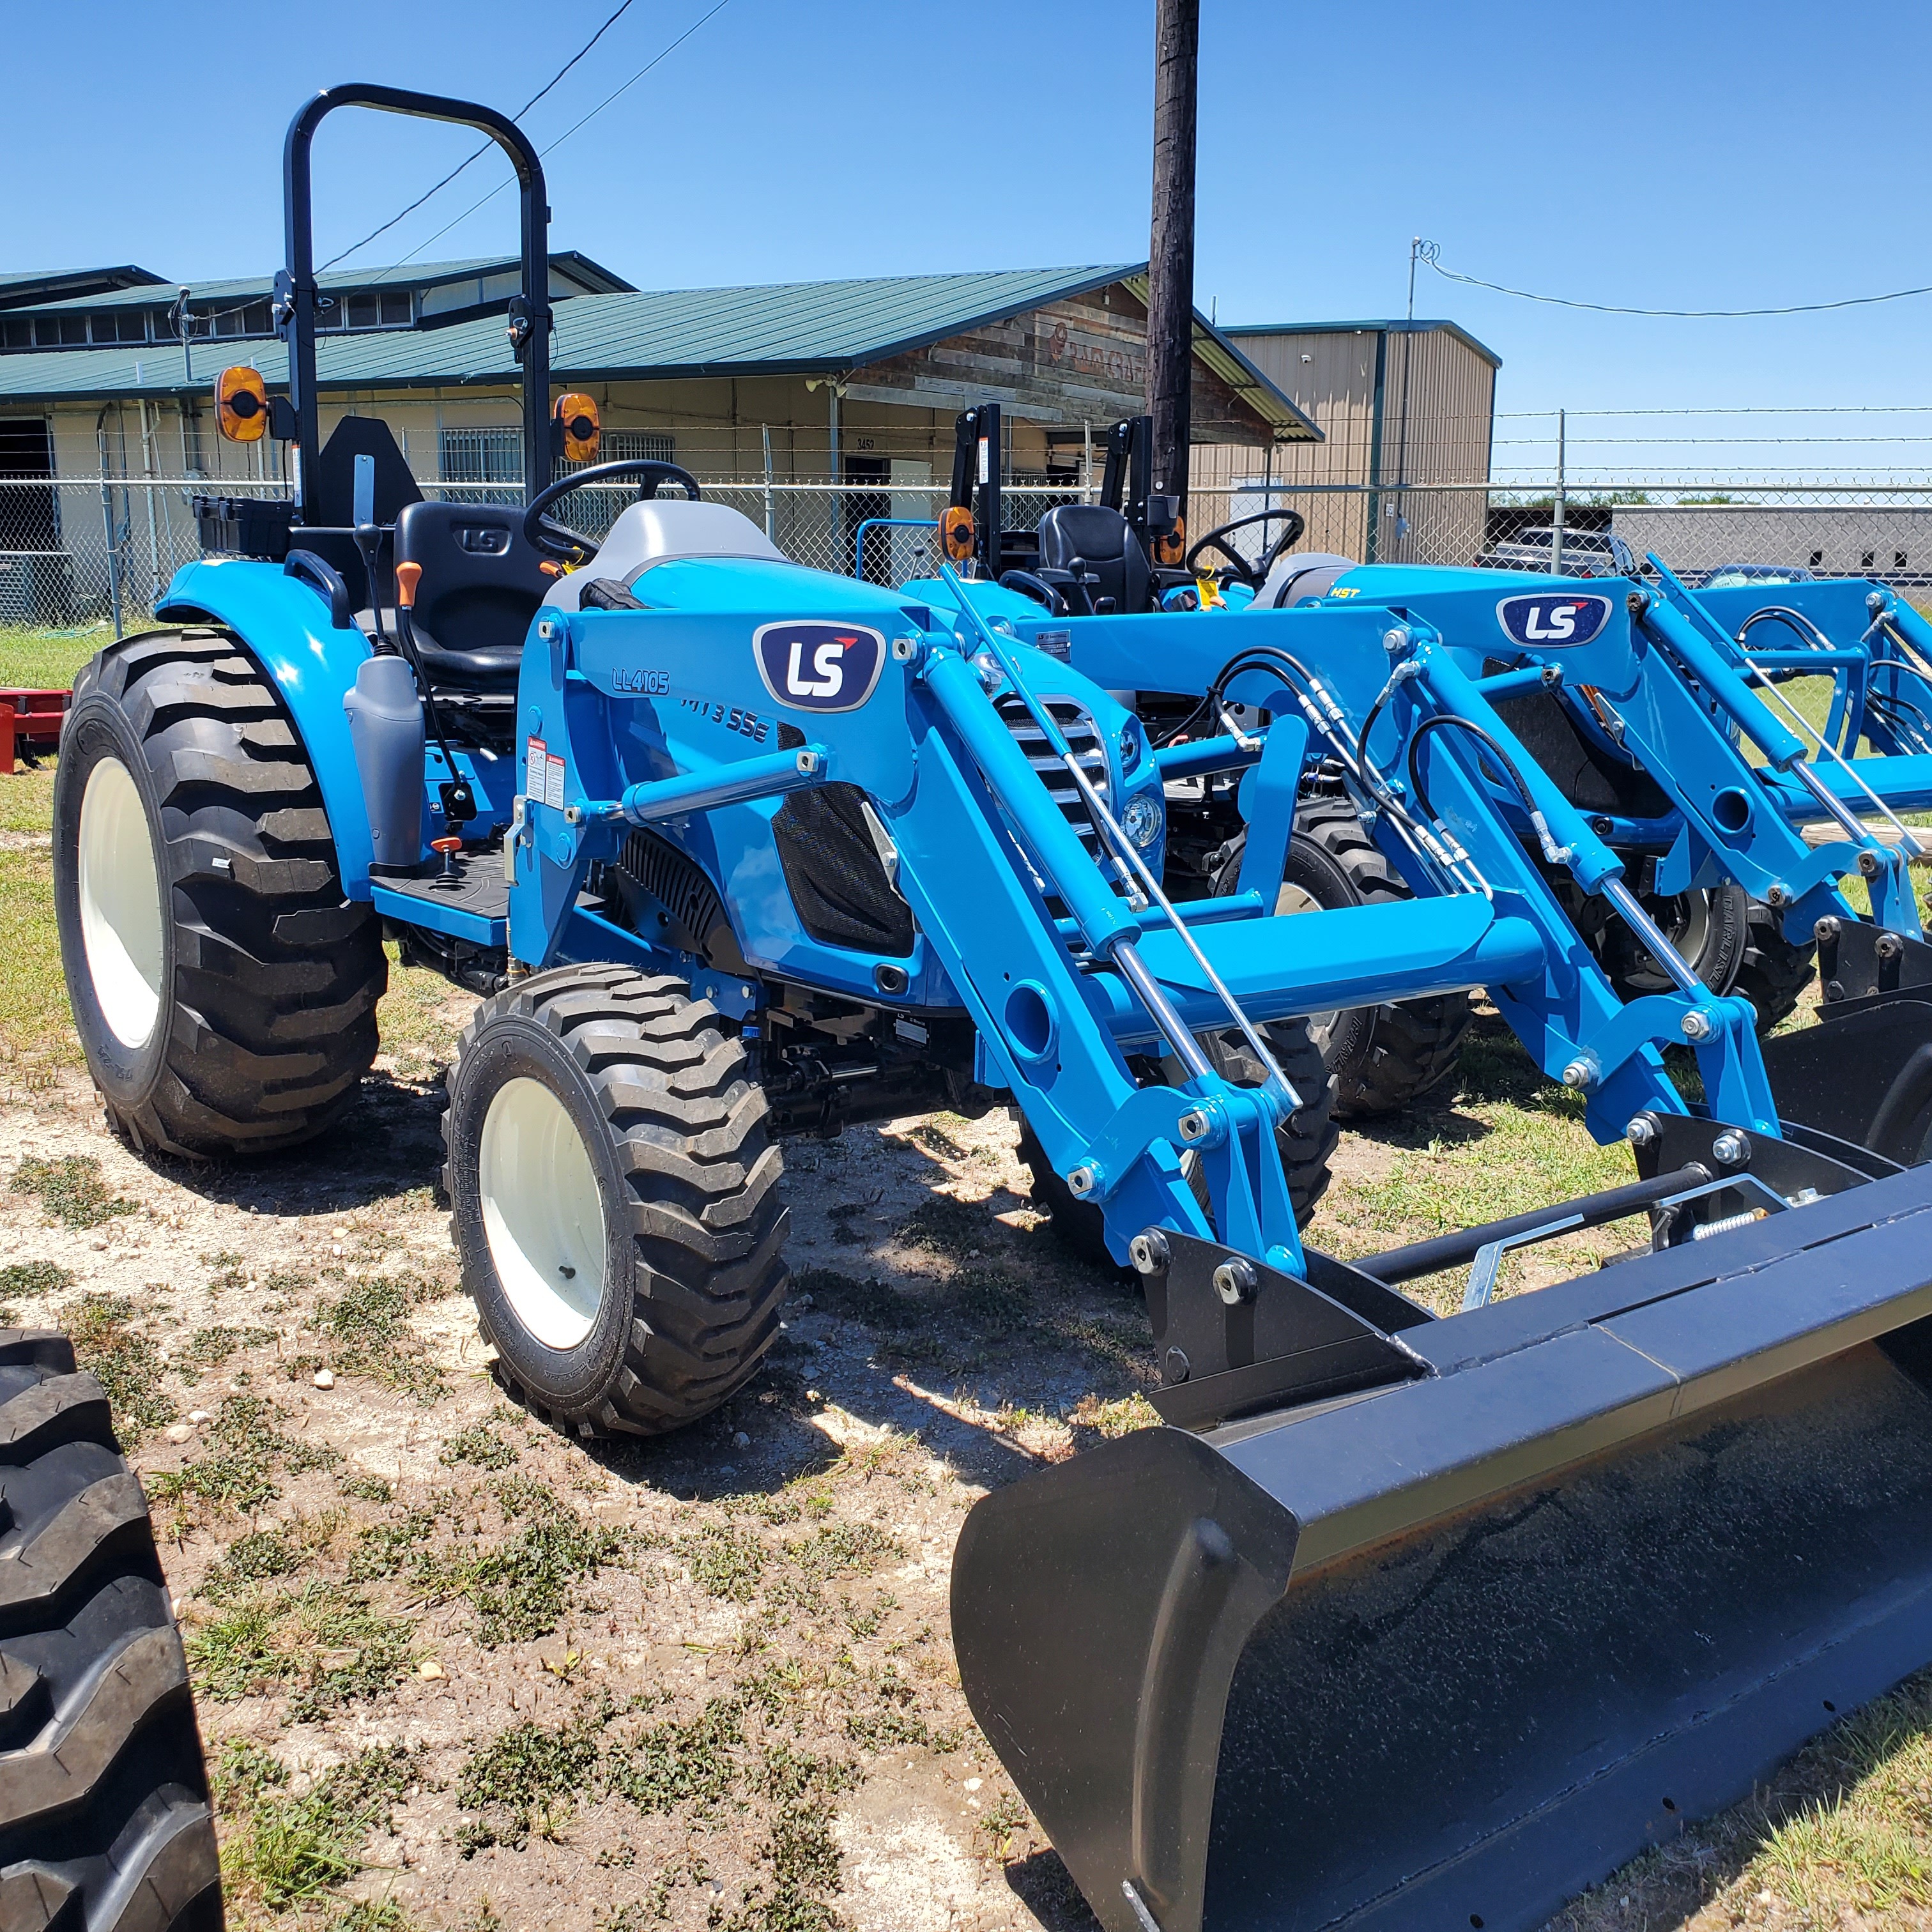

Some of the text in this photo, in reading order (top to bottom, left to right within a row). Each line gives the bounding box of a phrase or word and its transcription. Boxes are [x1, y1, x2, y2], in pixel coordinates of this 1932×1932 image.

[857, 438, 875, 450] 3452
[463, 530, 498, 553] LS
[1331, 587, 1361, 599] HST
[1525, 605, 1576, 640] LS
[611, 666, 670, 695] LL4105
[787, 642, 843, 697] LS
